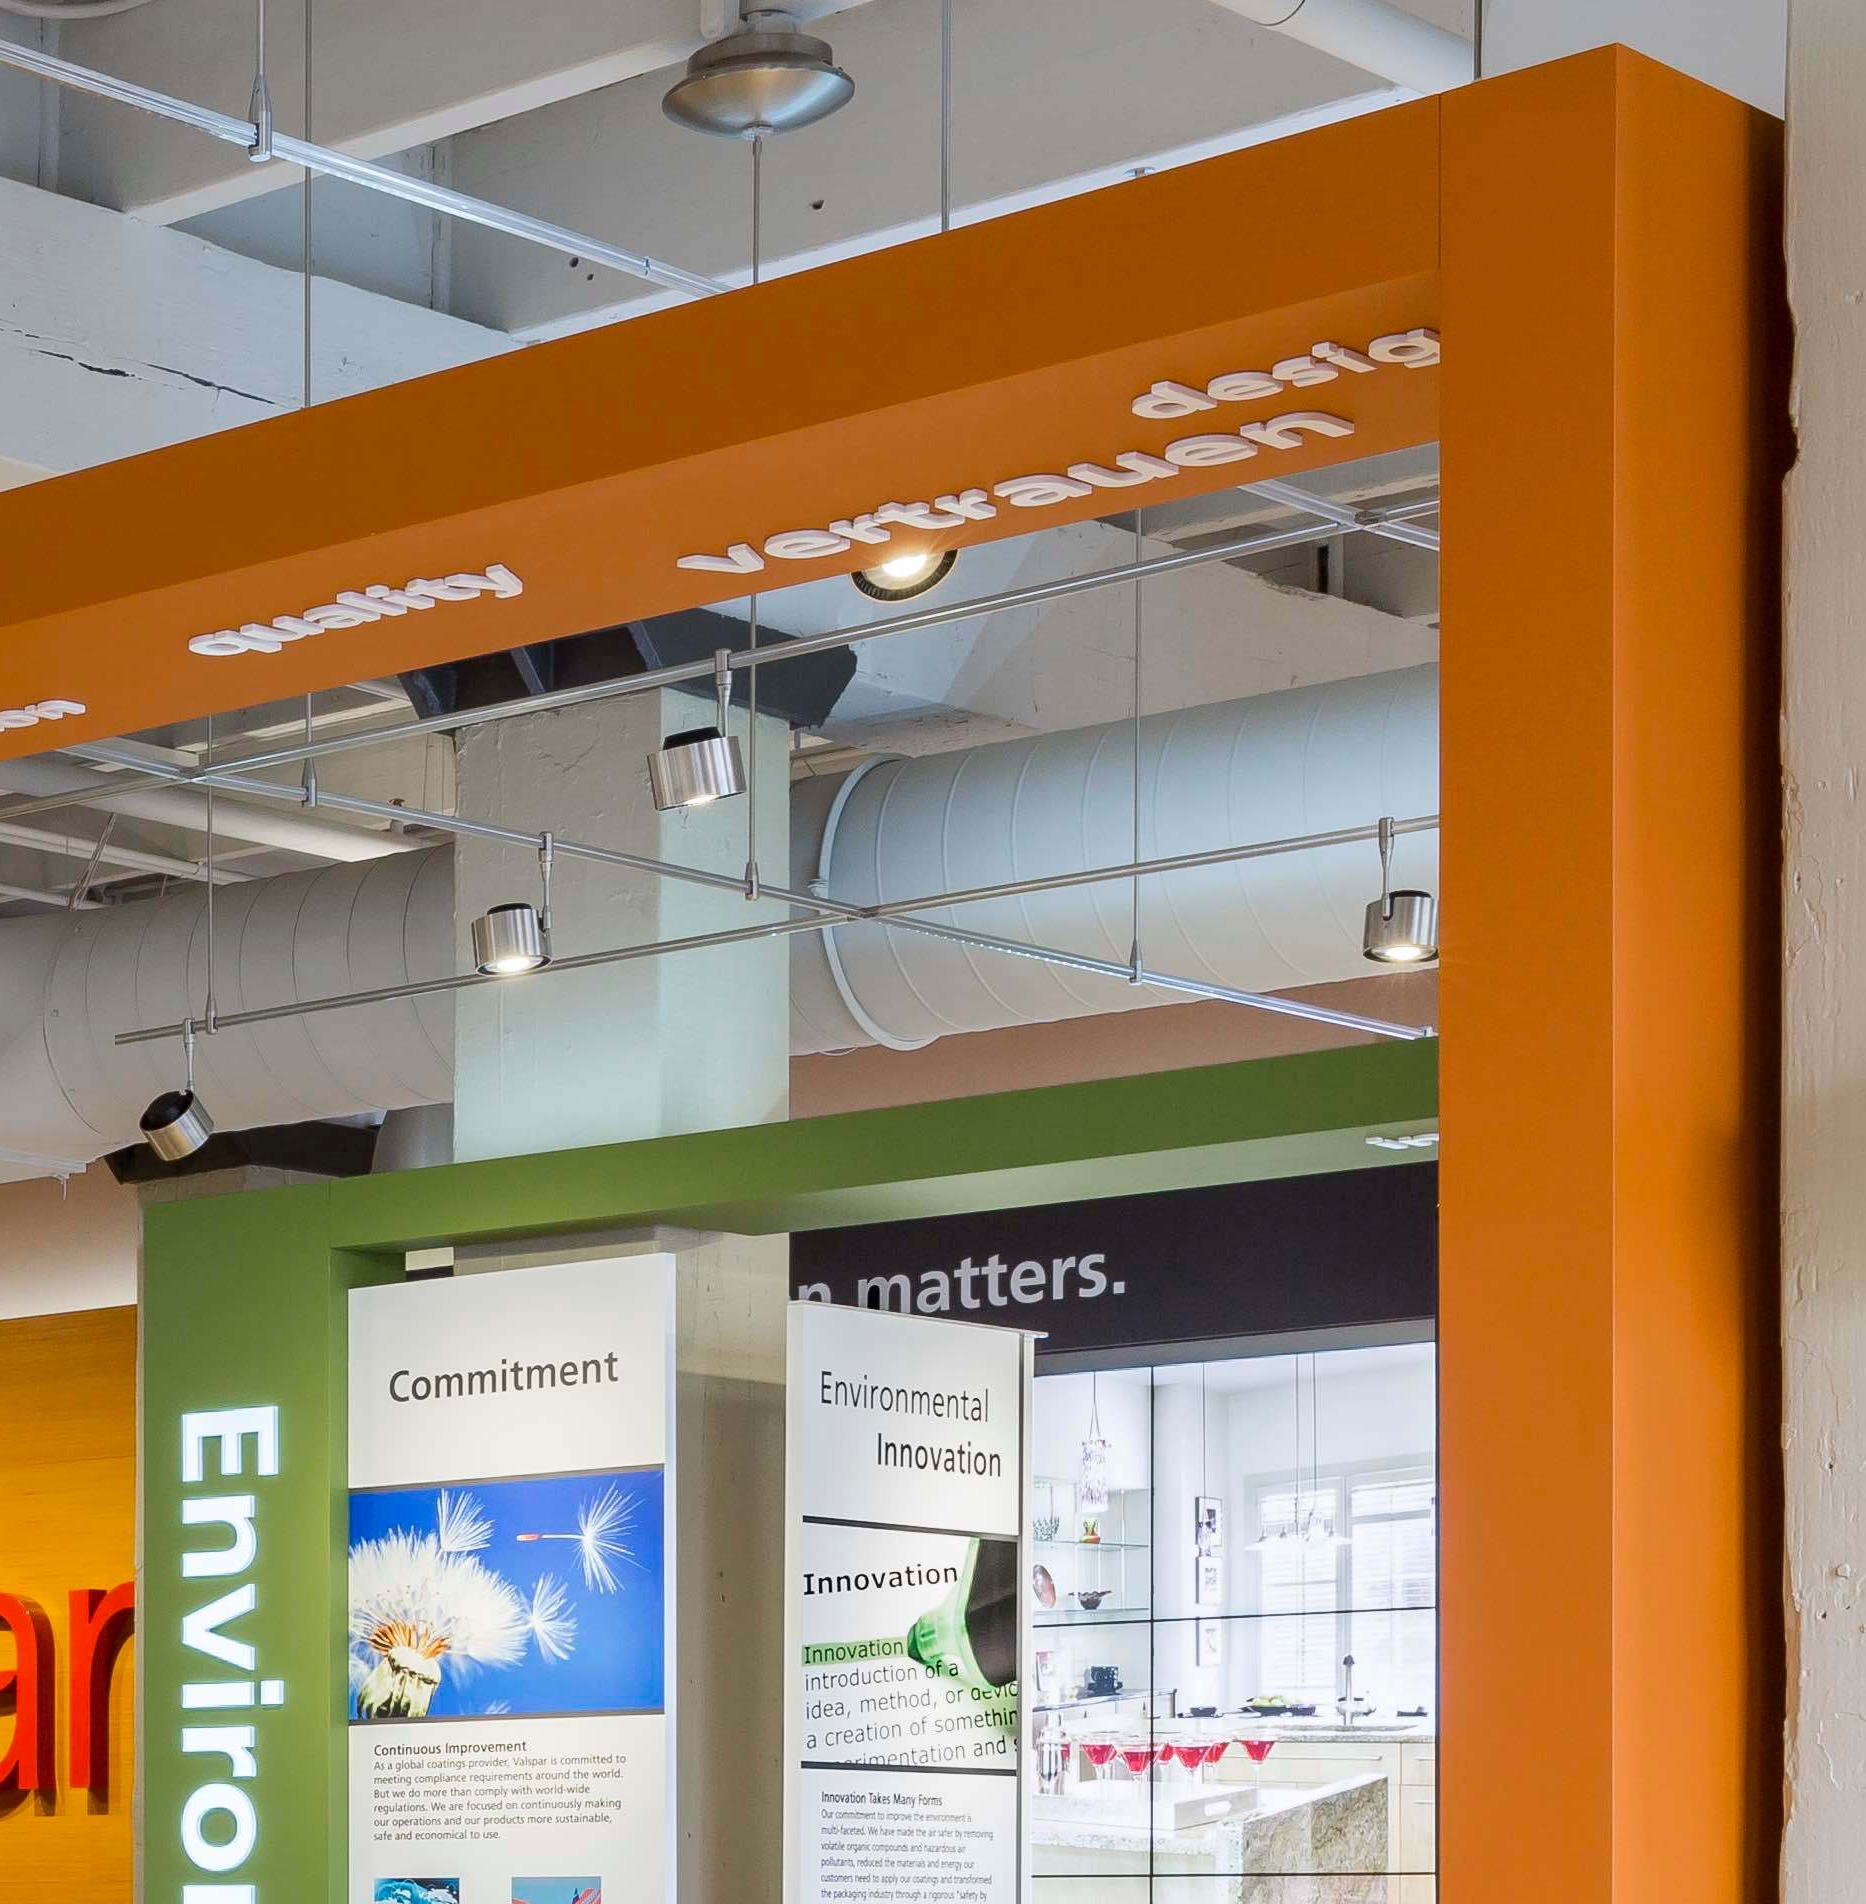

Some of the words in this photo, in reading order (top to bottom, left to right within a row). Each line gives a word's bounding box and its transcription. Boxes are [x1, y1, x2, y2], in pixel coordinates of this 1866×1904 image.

[677, 411, 1355, 574] vertrauen
[189, 564, 523, 656] quality
[858, 1253, 1125, 1314] matters.
[389, 1352, 618, 1402] Commitment
[820, 1371, 989, 1422] Environmental
[877, 1433, 1001, 1477] Innovation
[803, 1564, 958, 1595] Innovation
[804, 1640, 904, 1664] Innovation
[805, 1666, 917, 1691] introduction
[925, 1661, 942, 1679] of
[949, 1663, 959, 1677] a
[806, 1701, 851, 1719] idea,
[860, 1691, 937, 1713] method,
[946, 1689, 963, 1703] or
[806, 1735, 817, 1749] a
[825, 1722, 902, 1746] creation
[910, 1716, 928, 1735] of
[973, 1735, 1006, 1756] and
[373, 1743, 442, 1757] Continuous
[445, 1741, 527, 1757] Improvement
[821, 1790, 867, 1804] Innovation
[867, 1791, 895, 1805] Takes
[892, 1792, 917, 1809] Many
[918, 1792, 943, 1807] Forms
